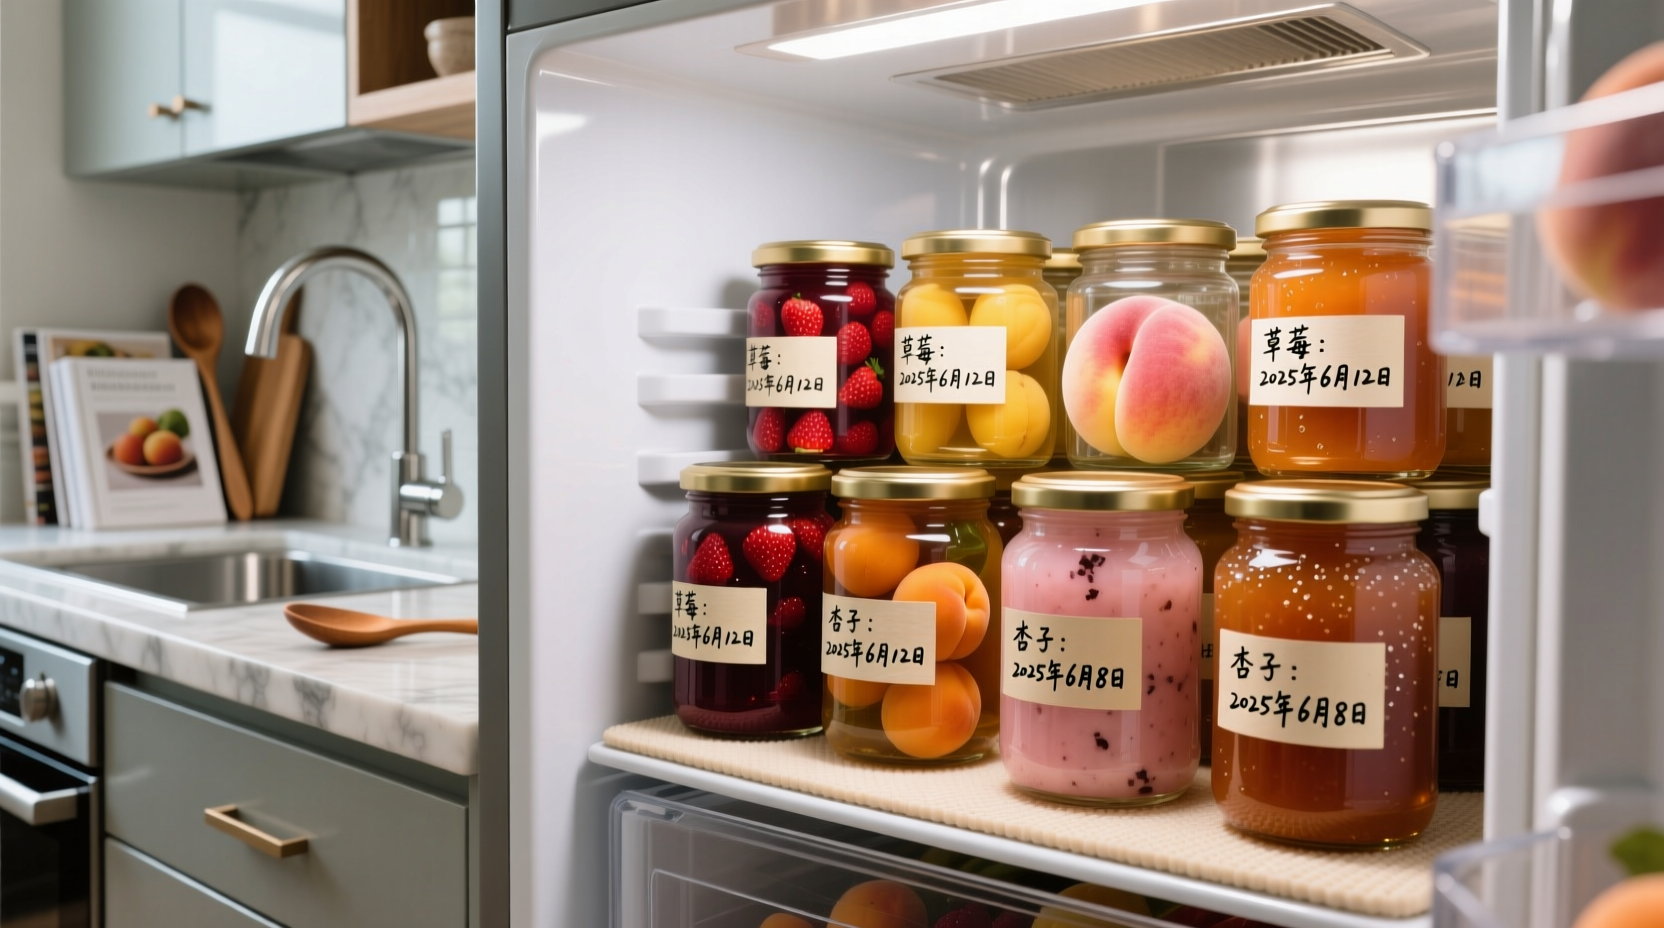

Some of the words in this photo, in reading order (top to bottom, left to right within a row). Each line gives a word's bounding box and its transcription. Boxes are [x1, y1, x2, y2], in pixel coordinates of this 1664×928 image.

[748, 344, 781, 371] 草莓：
[901, 334, 944, 365] 草莓：
[1263, 324, 1325, 362] 草莓：
[899, 367, 995, 393] 2025年6月12日
[1259, 363, 1391, 395] 2025年6月12日
[675, 590, 707, 621] 草莓：
[828, 605, 873, 633] 杏子：
[1013, 620, 1066, 653] 杏子：
[826, 639, 924, 668] 2025年6月12日
[1230, 646, 1297, 681] 杏子：
[1012, 659, 1124, 692] 2025年6月8日
[1229, 690, 1366, 728] 2025年6月8日
